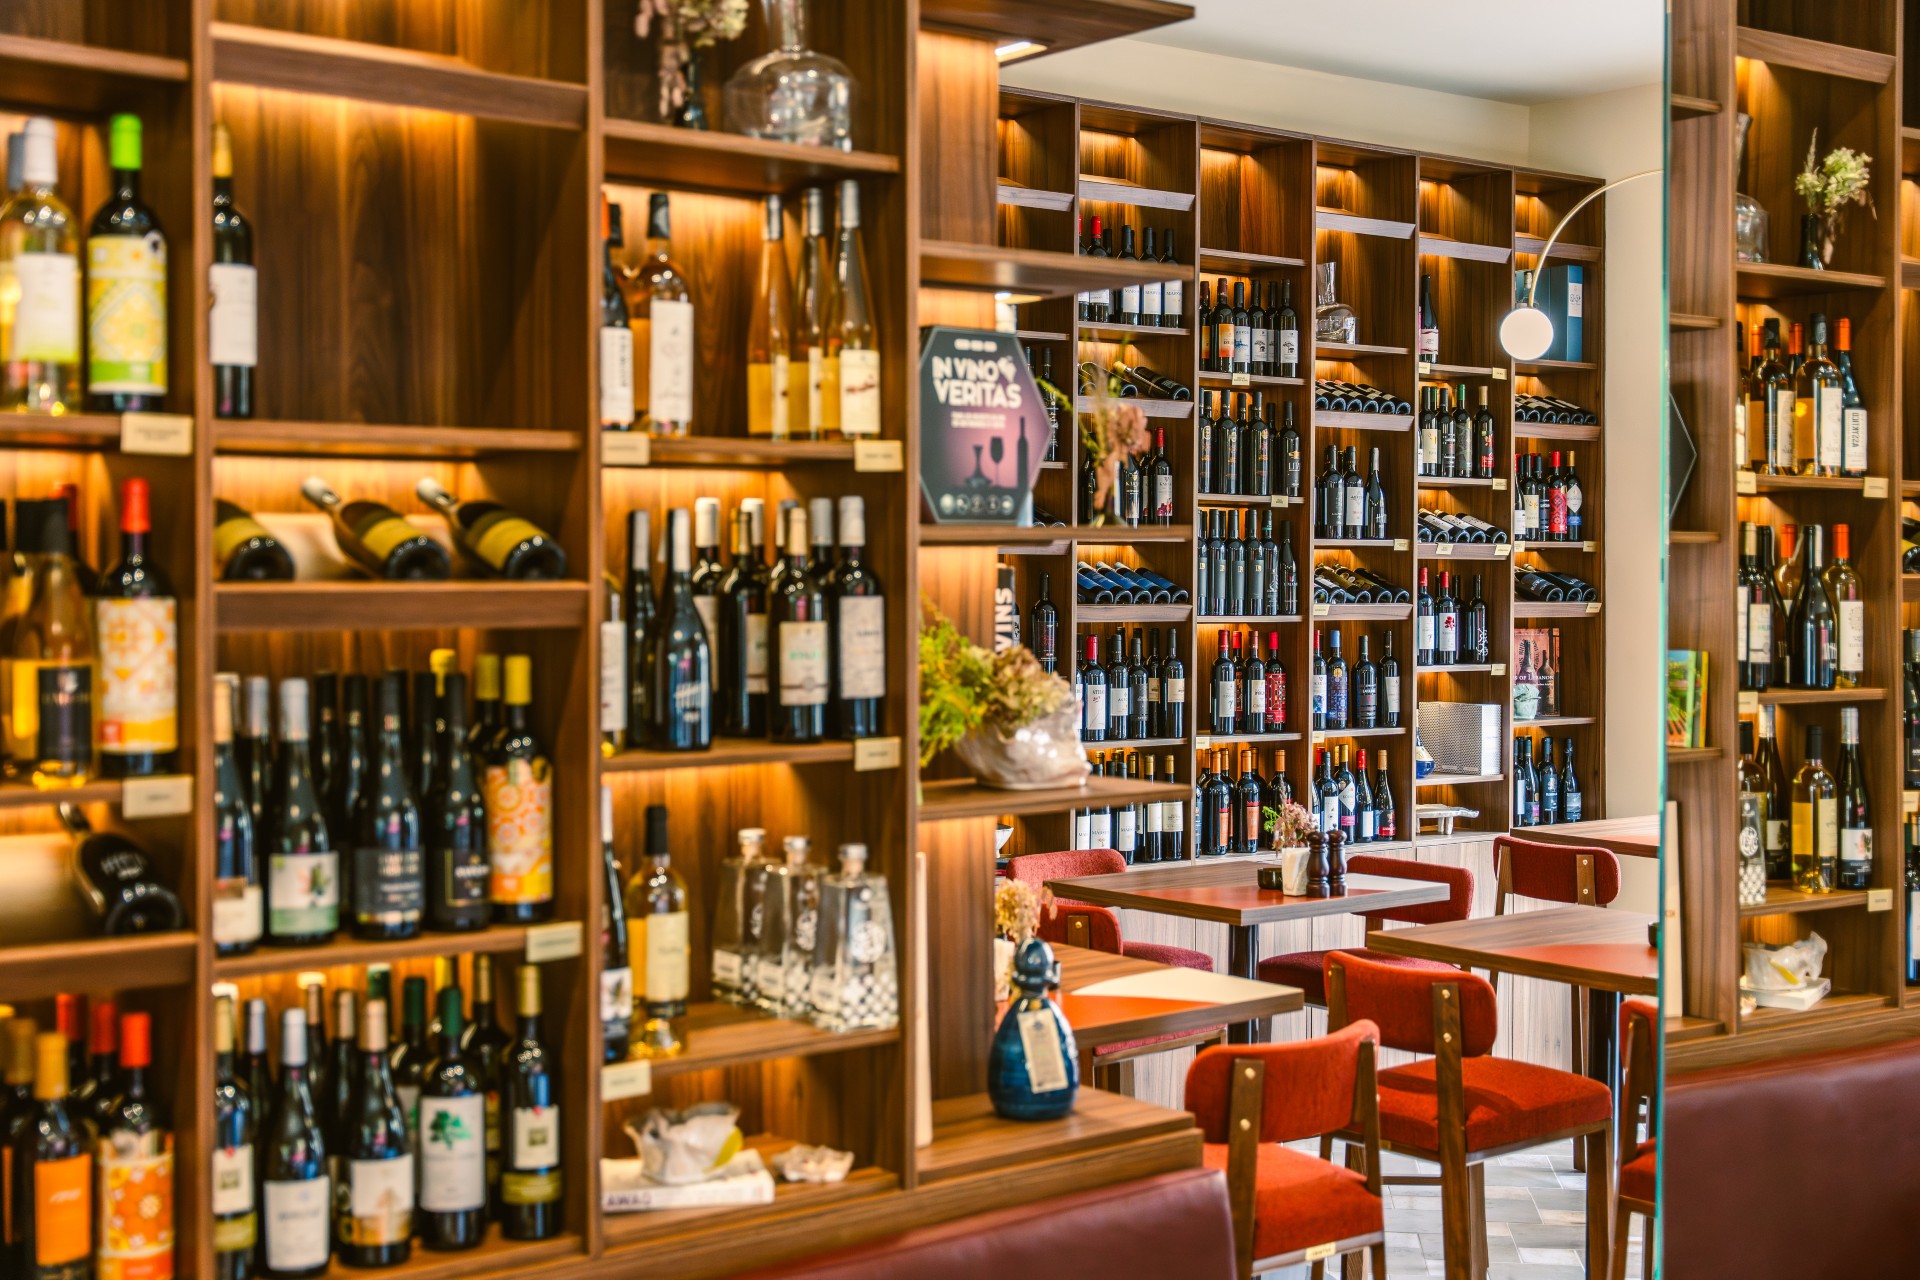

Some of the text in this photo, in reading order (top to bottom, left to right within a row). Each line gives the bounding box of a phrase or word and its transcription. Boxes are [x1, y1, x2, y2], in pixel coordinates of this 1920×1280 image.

[932, 356, 999, 382] IN VINO
[933, 379, 1022, 409] VERITAS
[995, 587, 1013, 654] VINS
